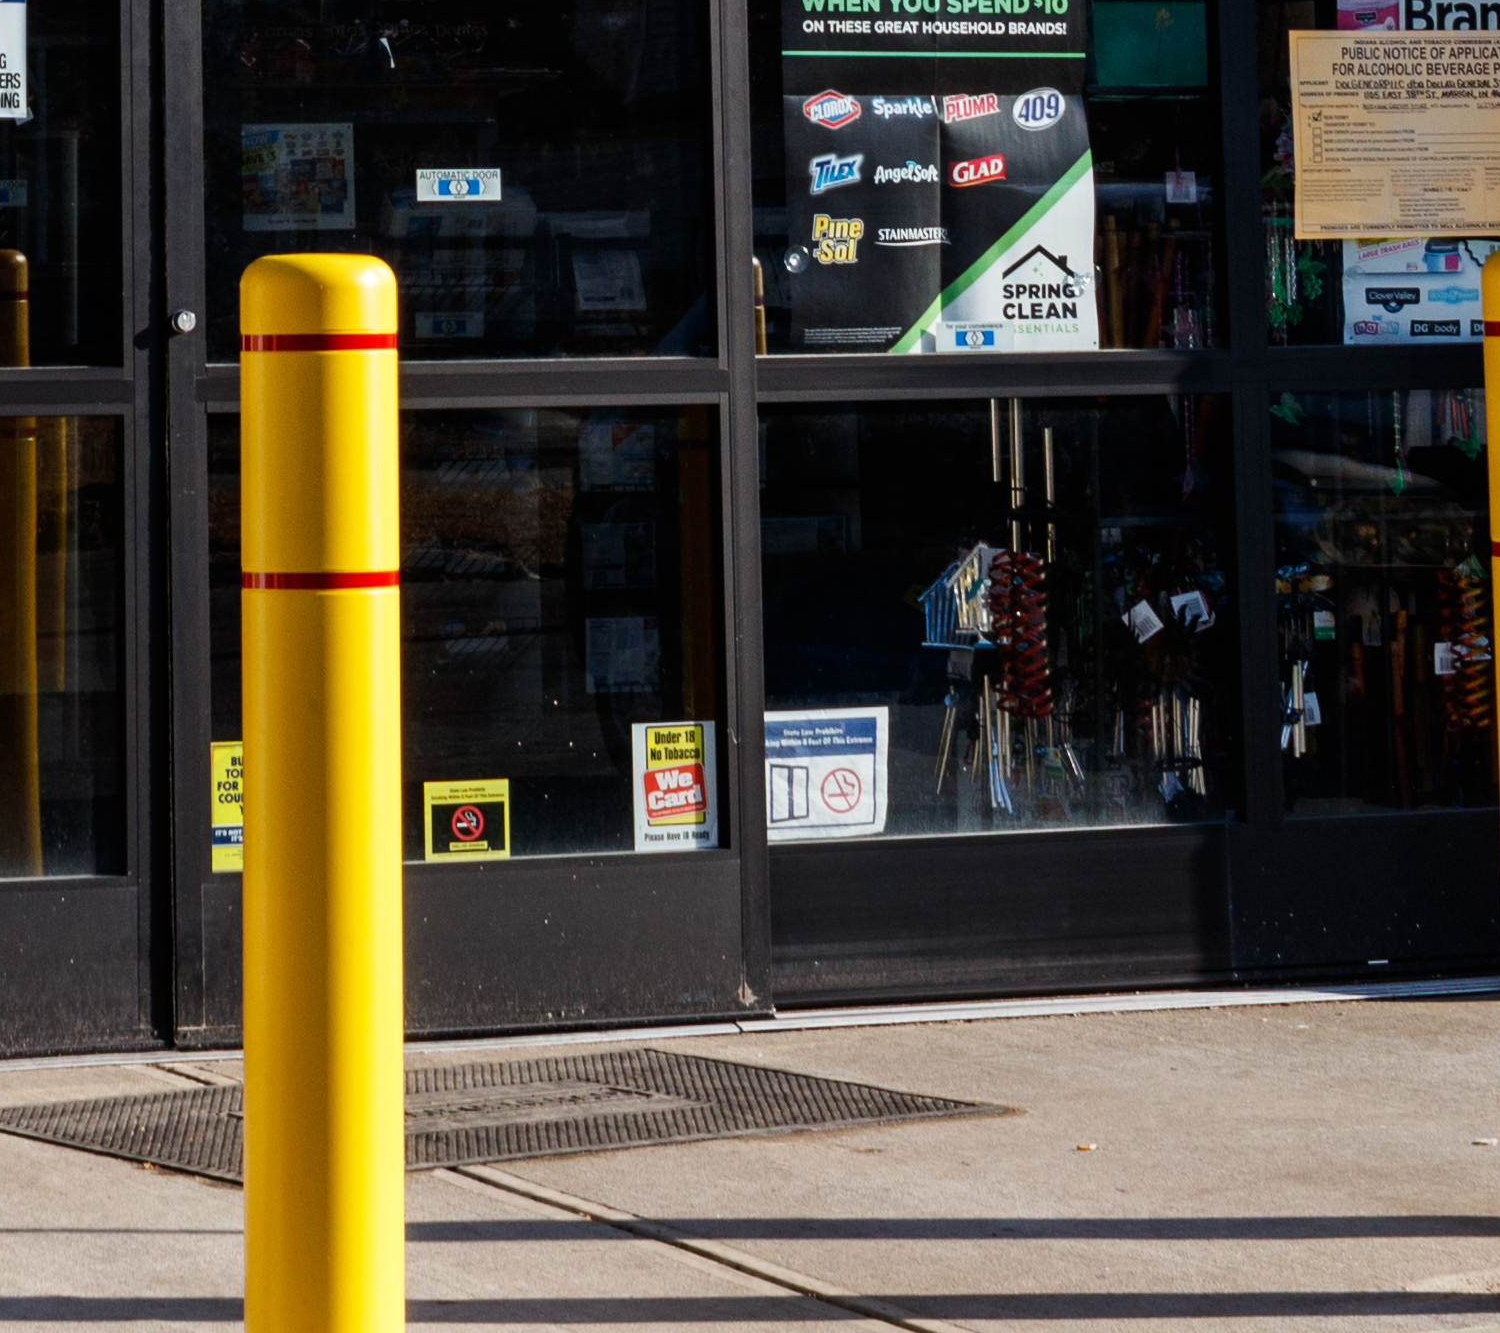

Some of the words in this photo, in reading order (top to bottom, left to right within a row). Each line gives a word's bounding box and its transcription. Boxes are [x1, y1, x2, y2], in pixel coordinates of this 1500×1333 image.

[802, 20, 825, 33] ON
[827, 20, 871, 33] THESE
[874, 21, 919, 34] GREAT
[922, 21, 1005, 35] HOUSEHOLD
[1008, 22, 1067, 35] BRANDS!
[1341, 47, 1380, 60] PUBLIC
[1383, 47, 1426, 60] NOTICE
[1430, 46, 1445, 59] OF
[1332, 63, 1355, 76] FOR
[1358, 63, 1422, 76] ALCOHOLIC
[1426, 62, 1490, 75] BEVERAGE
[808, 99, 853, 121] CLOROX
[872, 97, 933, 119] Sparkle
[1017, 93, 1060, 122] 409
[419, 171, 470, 180] AUTOMATIC
[472, 170, 498, 179] DOOR
[814, 214, 863, 240] Pine
[1002, 284, 1076, 299] SPRING
[1002, 302, 1077, 320] CLEAN
[1014, 323, 1080, 334] SENTIALS
[654, 731, 681, 744] Under
[685, 730, 695, 743] 18
[650, 748, 662, 761] No
[664, 746, 700, 760] Tobacco
[217, 781, 238, 791] FOR
[654, 770, 693, 790] We
[647, 785, 703, 810] Card
[644, 832, 664, 842] Please
